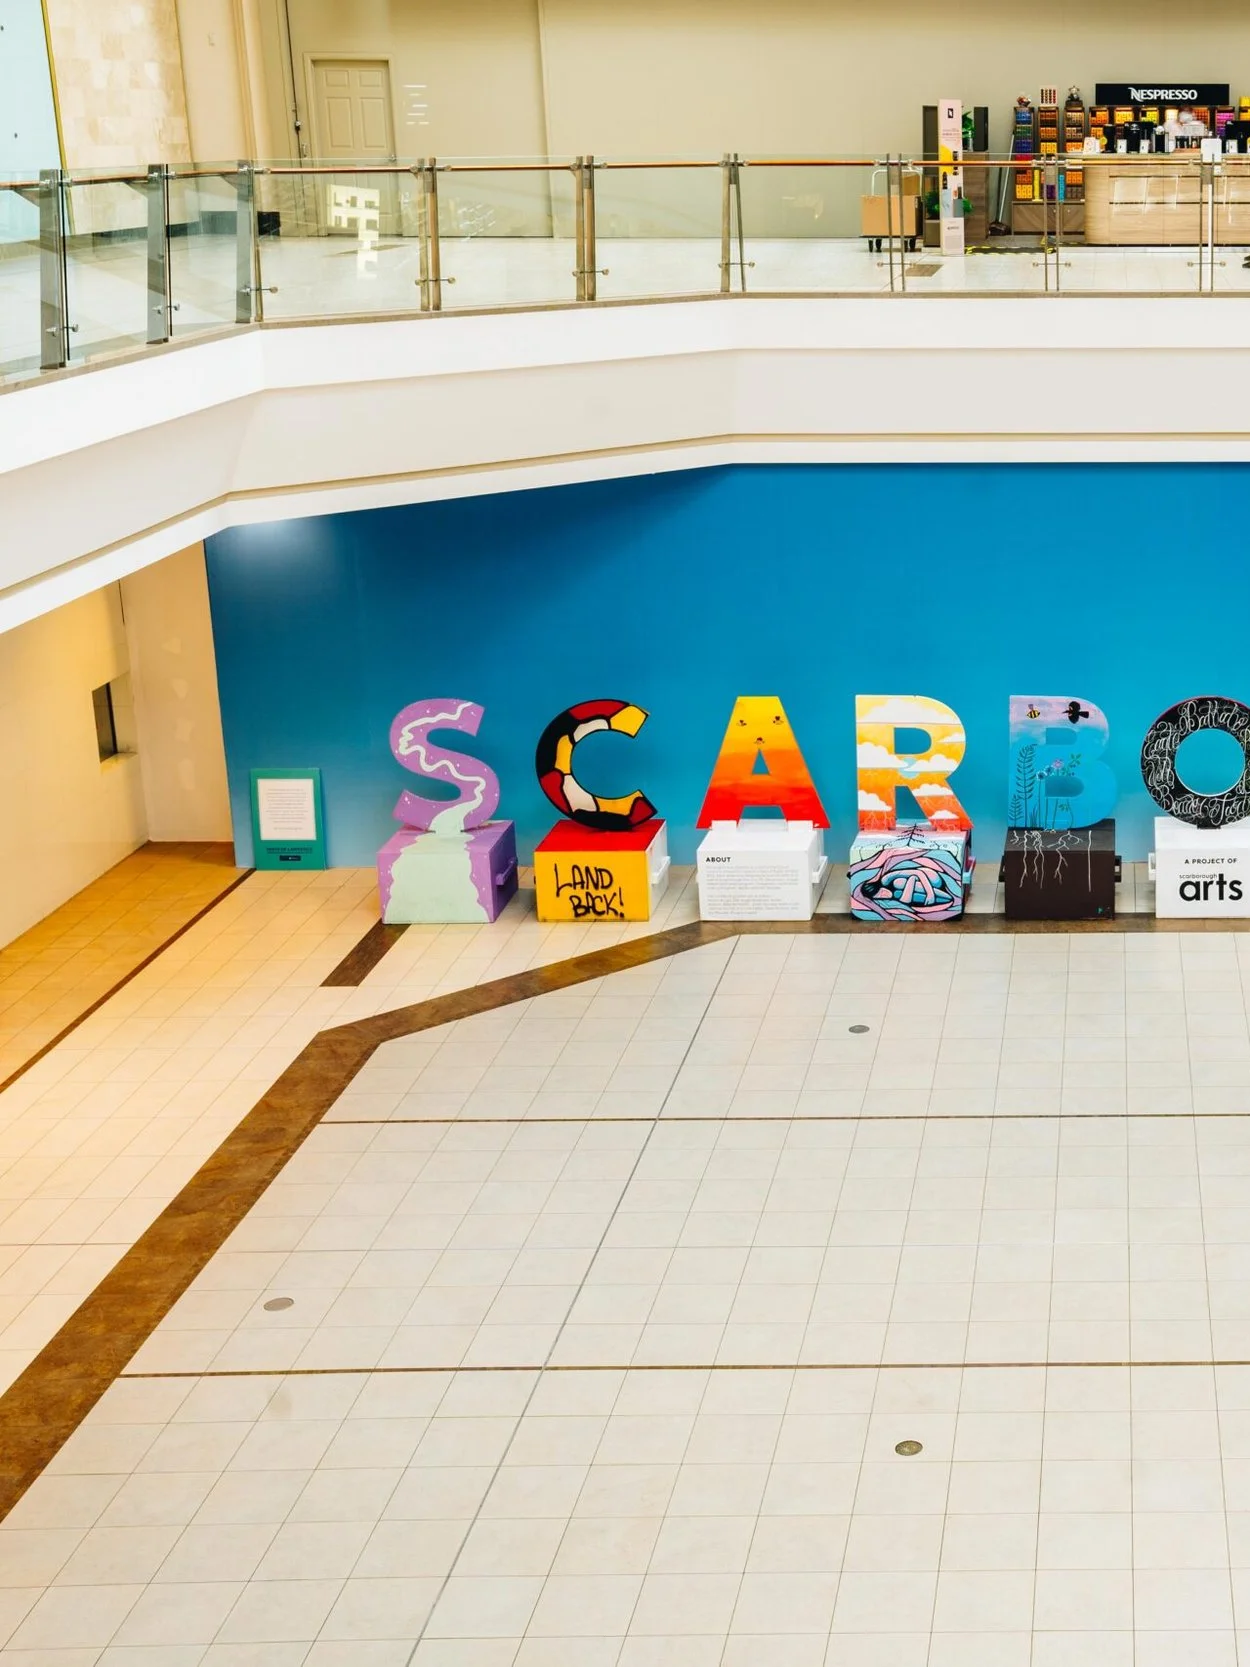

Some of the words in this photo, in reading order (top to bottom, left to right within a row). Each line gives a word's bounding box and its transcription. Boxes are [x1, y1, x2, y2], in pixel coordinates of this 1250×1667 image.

[1128, 87, 1198, 102] NESPRESSO
[554, 863, 614, 898] LAND
[1179, 873, 1243, 901] arts
[569, 886, 625, 918] BACK!
